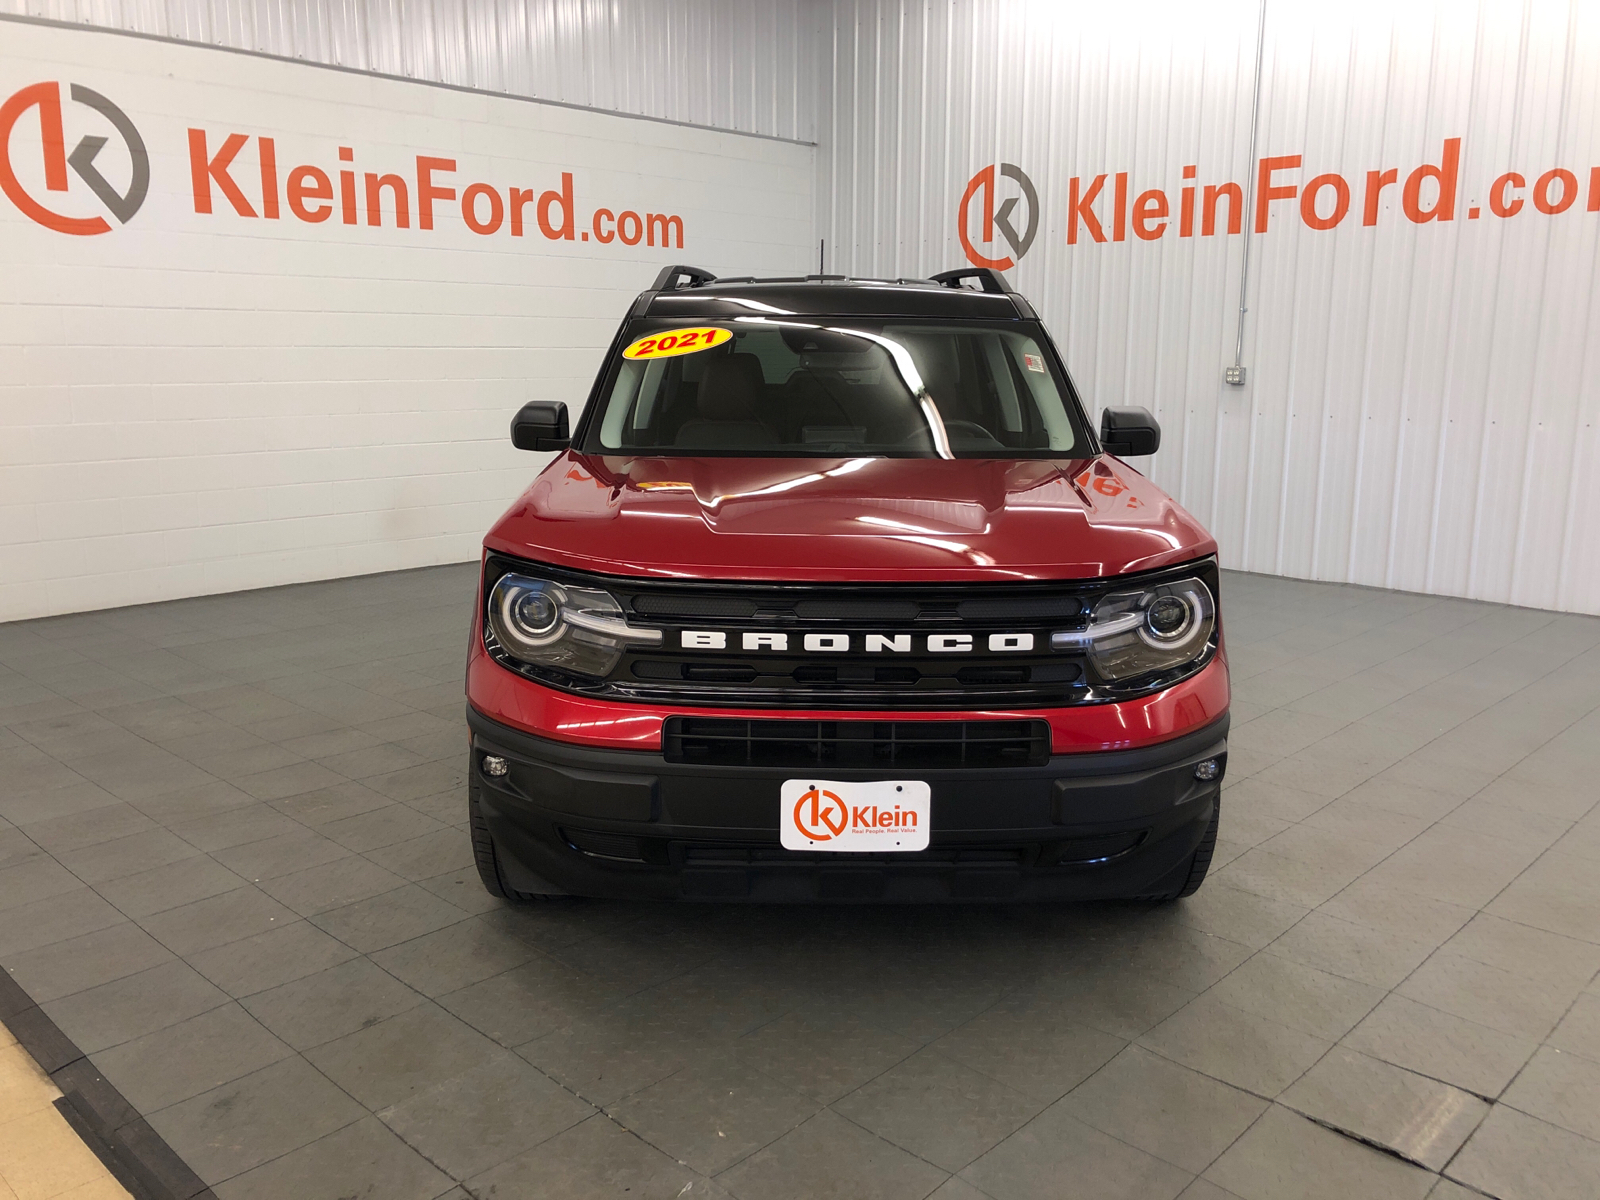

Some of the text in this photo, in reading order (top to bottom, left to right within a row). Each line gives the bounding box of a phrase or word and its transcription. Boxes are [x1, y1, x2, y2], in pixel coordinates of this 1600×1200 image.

[187, 127, 684, 249] KleinFord.com
[1067, 138, 1600, 245] KleinFord.co
[635, 330, 717, 357] 2021
[681, 630, 1034, 652] BRONCO
[852, 805, 918, 828] Klein
